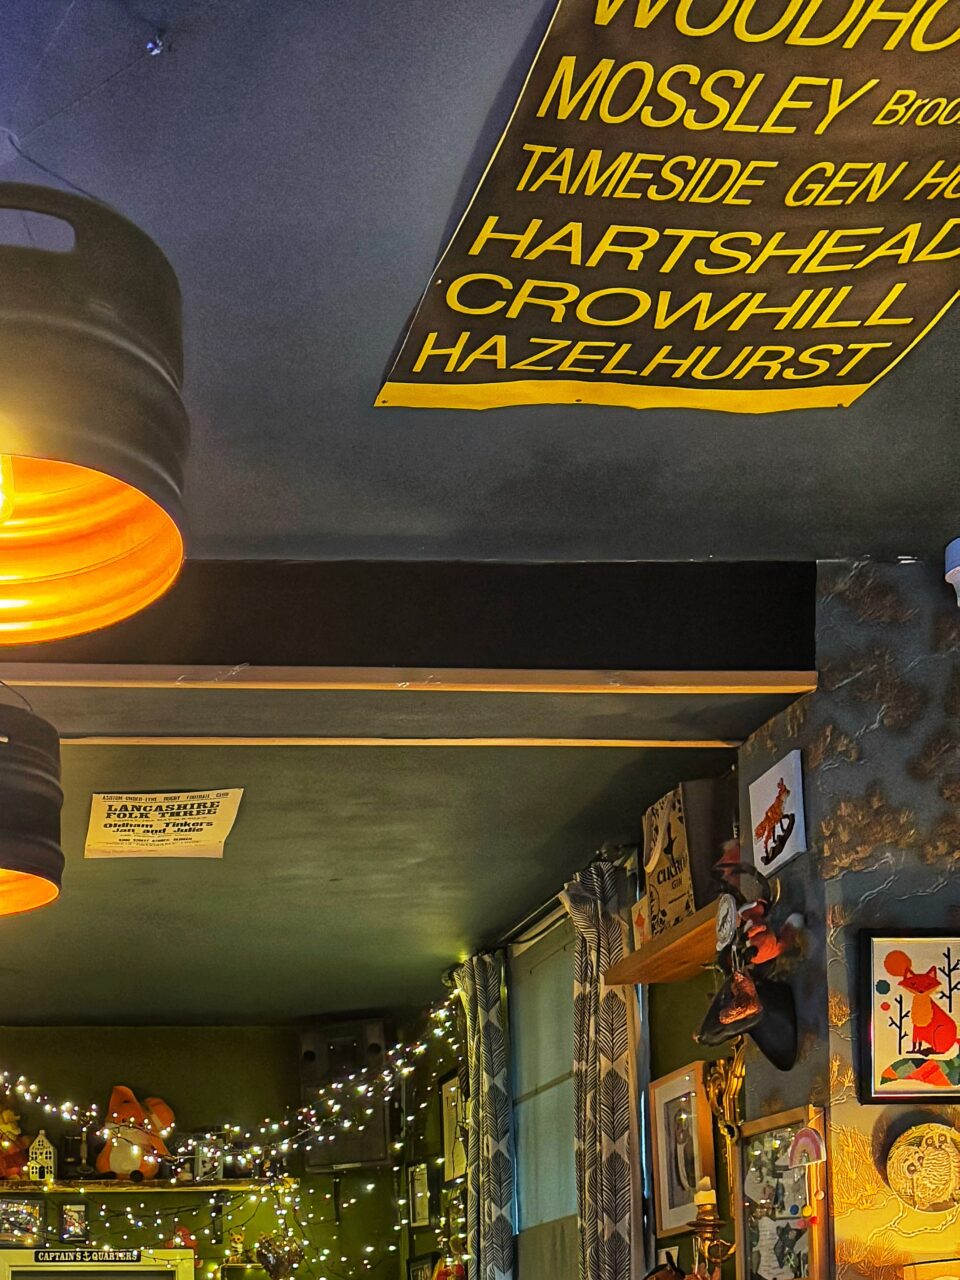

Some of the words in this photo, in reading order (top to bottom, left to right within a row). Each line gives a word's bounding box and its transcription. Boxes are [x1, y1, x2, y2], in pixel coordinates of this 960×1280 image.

[536, 56, 880, 135] MOSSLEY
[515, 143, 778, 206] TAMESIDE
[785, 161, 909, 207] GEN
[468, 216, 960, 275] HARTSHEAD
[445, 273, 915, 332] CROWHILL
[412, 332, 892, 380] HAZELHURST
[107, 801, 221, 812] LANCASHIRE
[158, 808, 217, 818] THREE
[671, 877, 683, 890] GIN
[38, 1252, 81, 1261] CAPTAIN'S
[92, 1252, 137, 1261] QUARTERS
